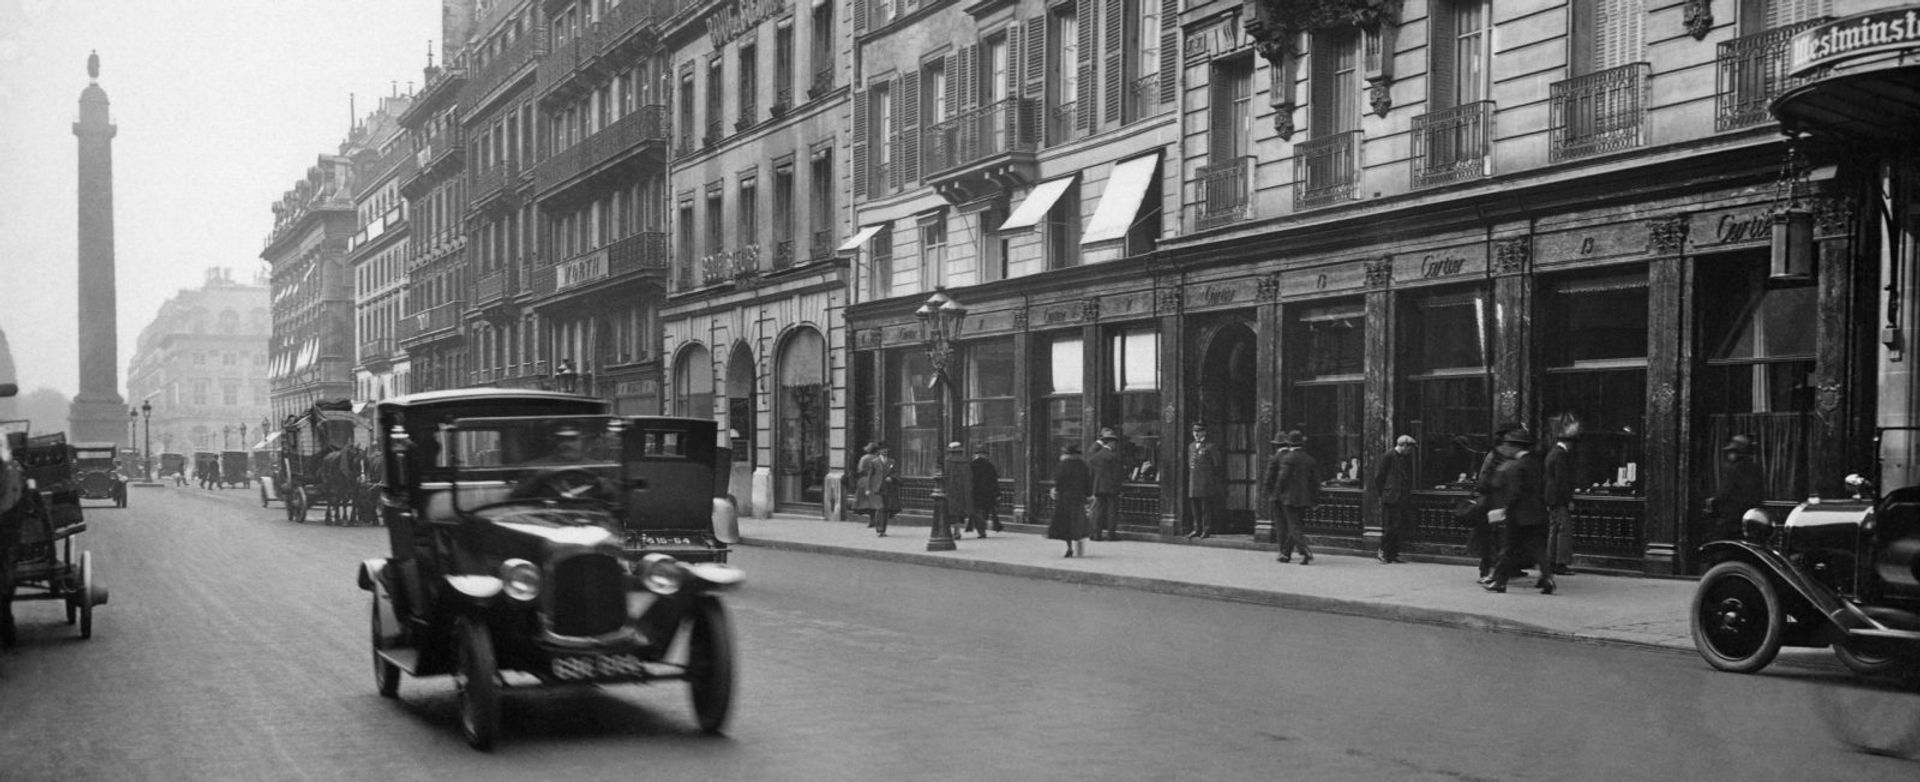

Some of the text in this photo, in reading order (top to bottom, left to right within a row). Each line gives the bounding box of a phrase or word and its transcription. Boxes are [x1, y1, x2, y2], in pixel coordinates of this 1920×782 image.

[1792, 10, 1920, 67] Westminst
[1716, 212, 1773, 243] Cartie
[1421, 254, 1467, 280] Cartier
